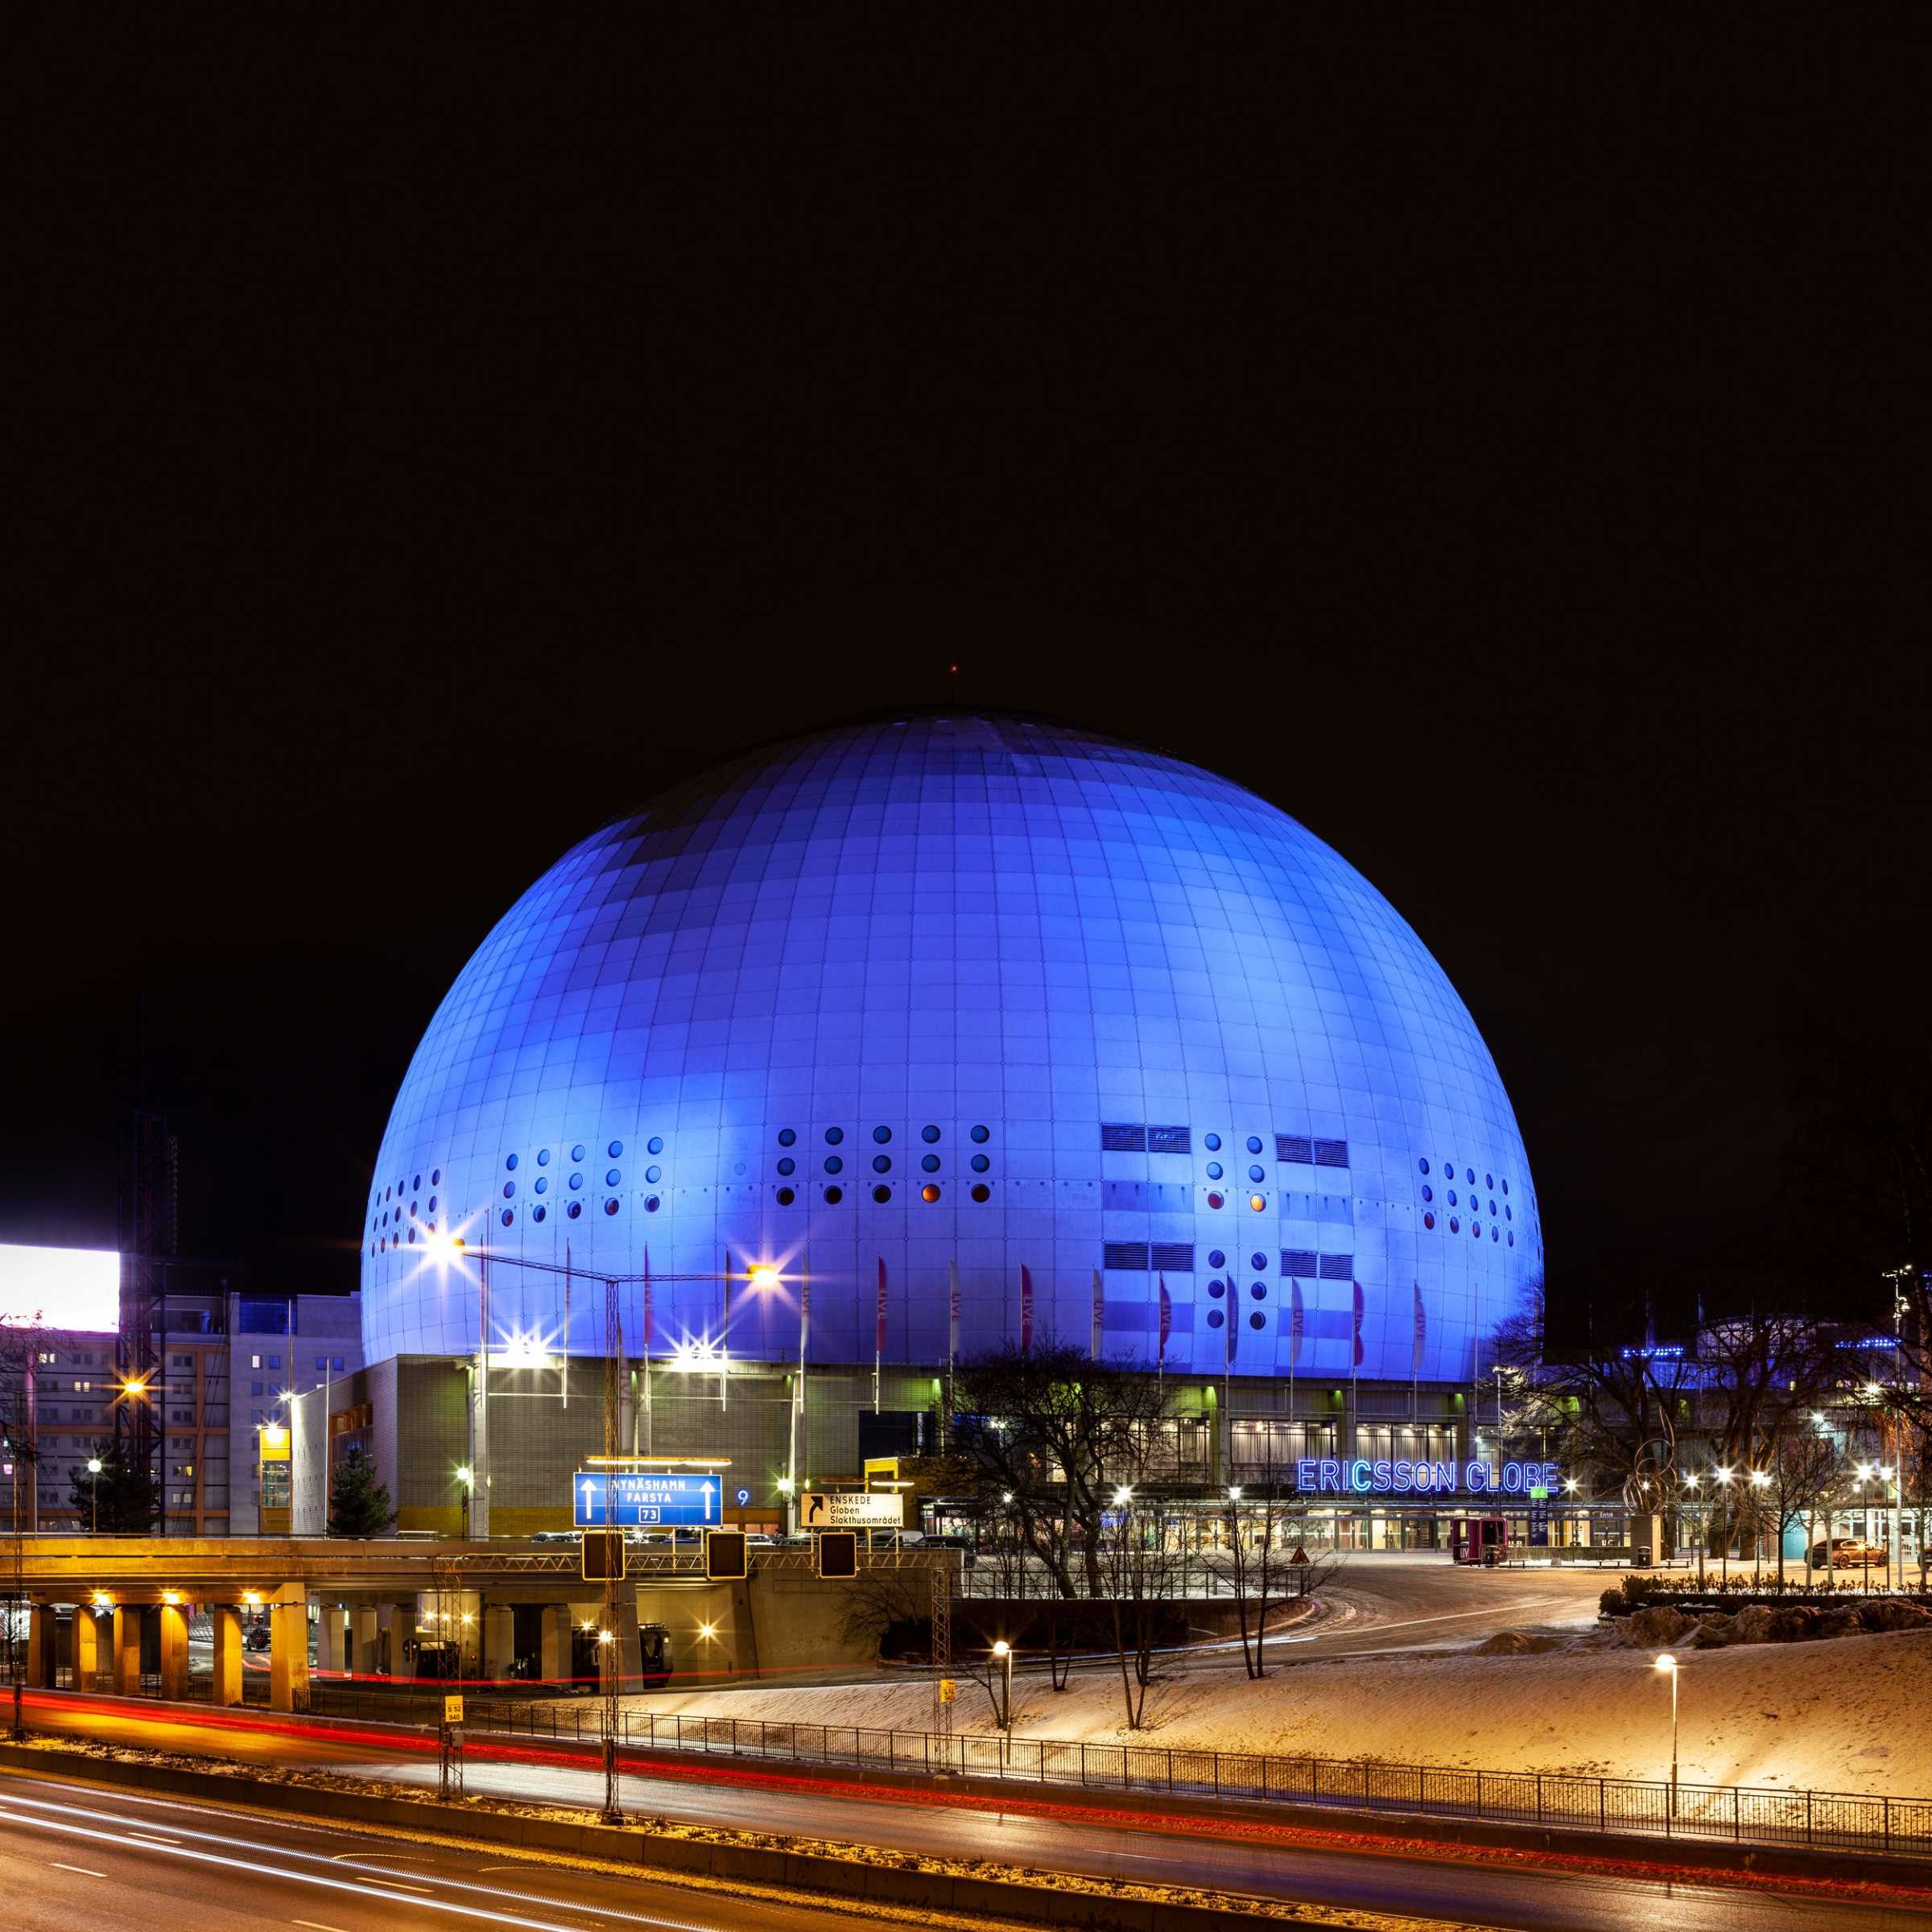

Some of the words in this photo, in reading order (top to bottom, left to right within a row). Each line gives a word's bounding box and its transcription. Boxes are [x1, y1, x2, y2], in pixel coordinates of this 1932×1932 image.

[878, 1290, 887, 1319] LIVE
[952, 1293, 961, 1321] LIVE
[1022, 1296, 1034, 1325] LIVE
[1094, 1300, 1104, 1329] LIVE
[1293, 1309, 1303, 1336] LIVE
[1416, 1315, 1426, 1340] LIVE
[1298, 1459, 1455, 1492] ERICSSON
[1466, 1462, 1559, 1492] GLOBE
[627, 1493, 671, 1503] FARSTA
[737, 1490, 749, 1505] 9
[830, 1496, 872, 1505] ENSKEDE
[830, 1506, 860, 1514] Globen
[642, 1509, 657, 1519] 73
[830, 1515, 901, 1524] Slakthusområdet
